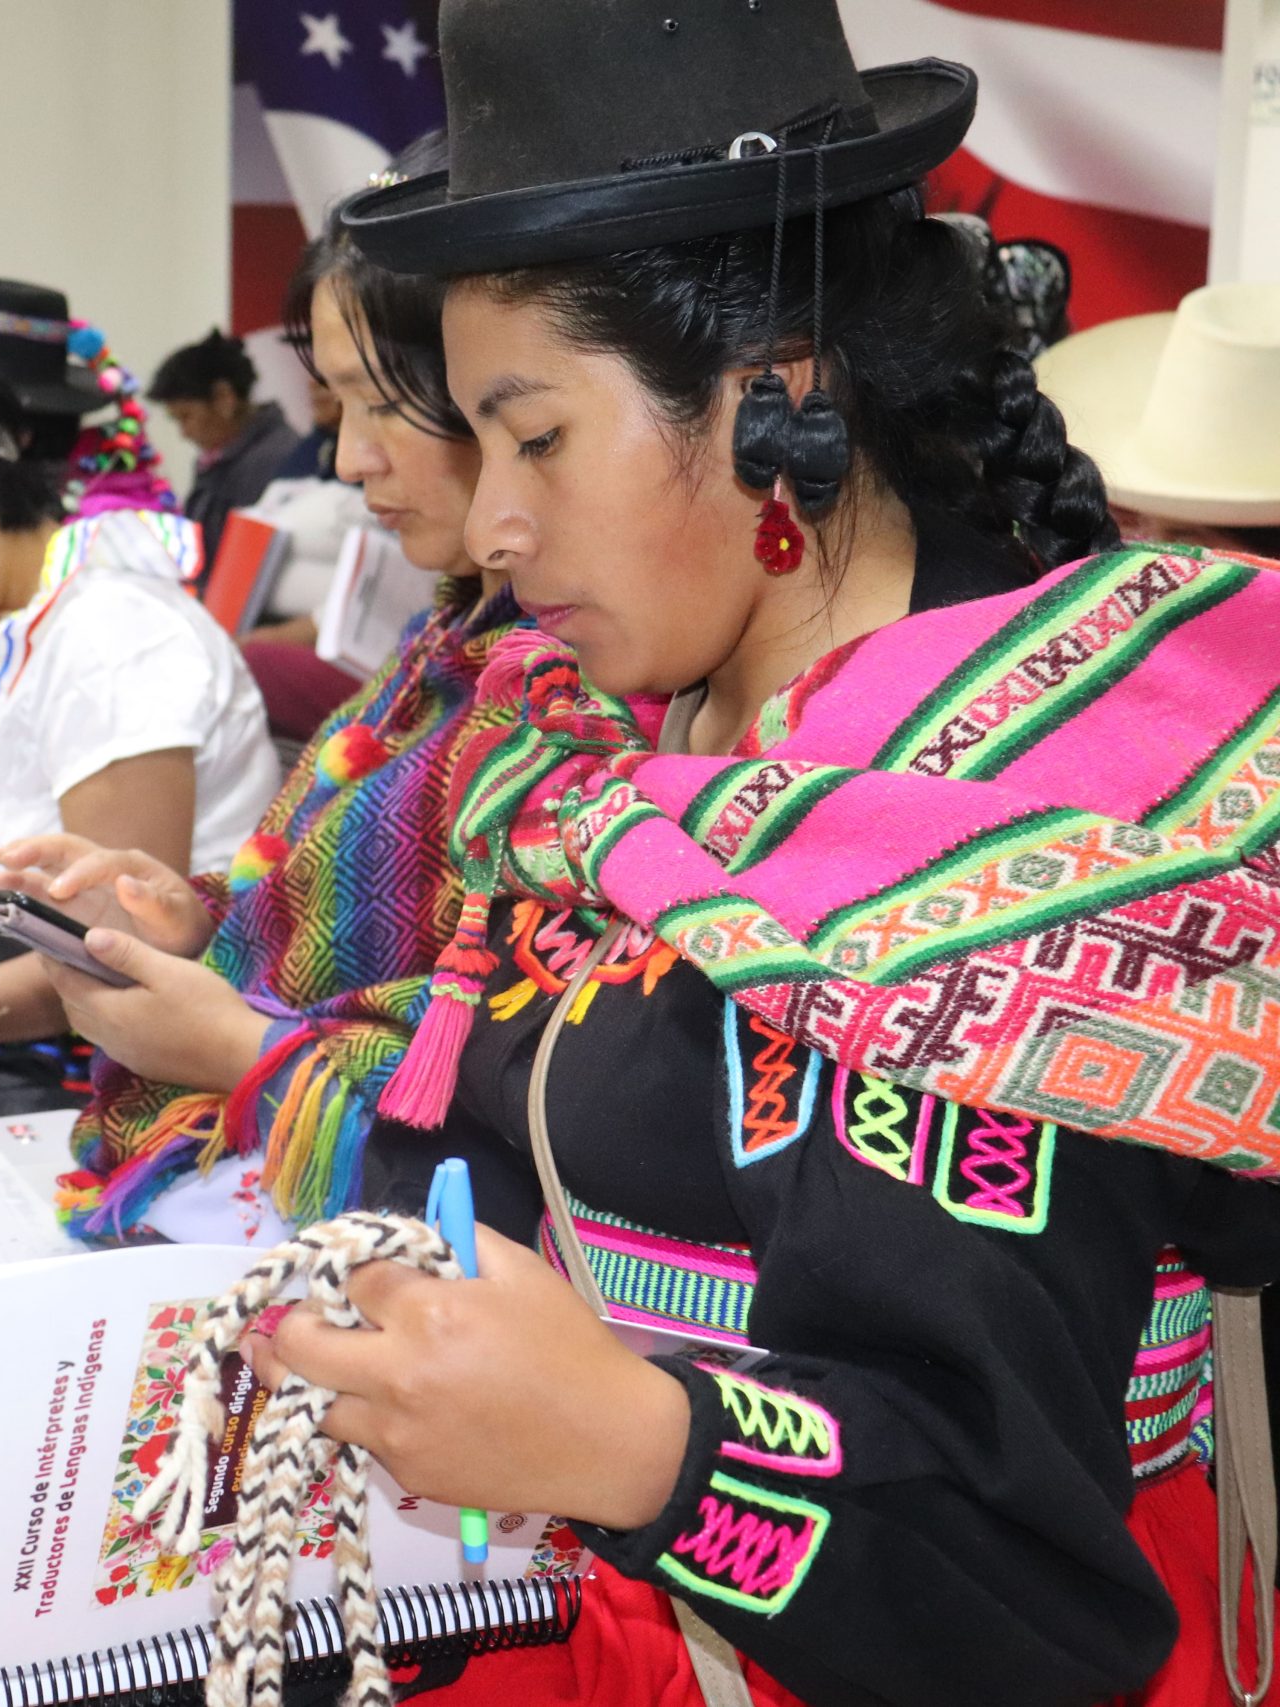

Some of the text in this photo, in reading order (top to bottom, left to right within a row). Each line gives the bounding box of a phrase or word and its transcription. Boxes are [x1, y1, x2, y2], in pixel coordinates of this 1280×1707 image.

[13, 1361, 76, 1592] XXII Curso de Intérpretes y
[35, 1318, 107, 1617] Traductores de Lenguas Indígenas
[205, 1455, 229, 1514] Segundo
[221, 1416, 240, 1453] curso
